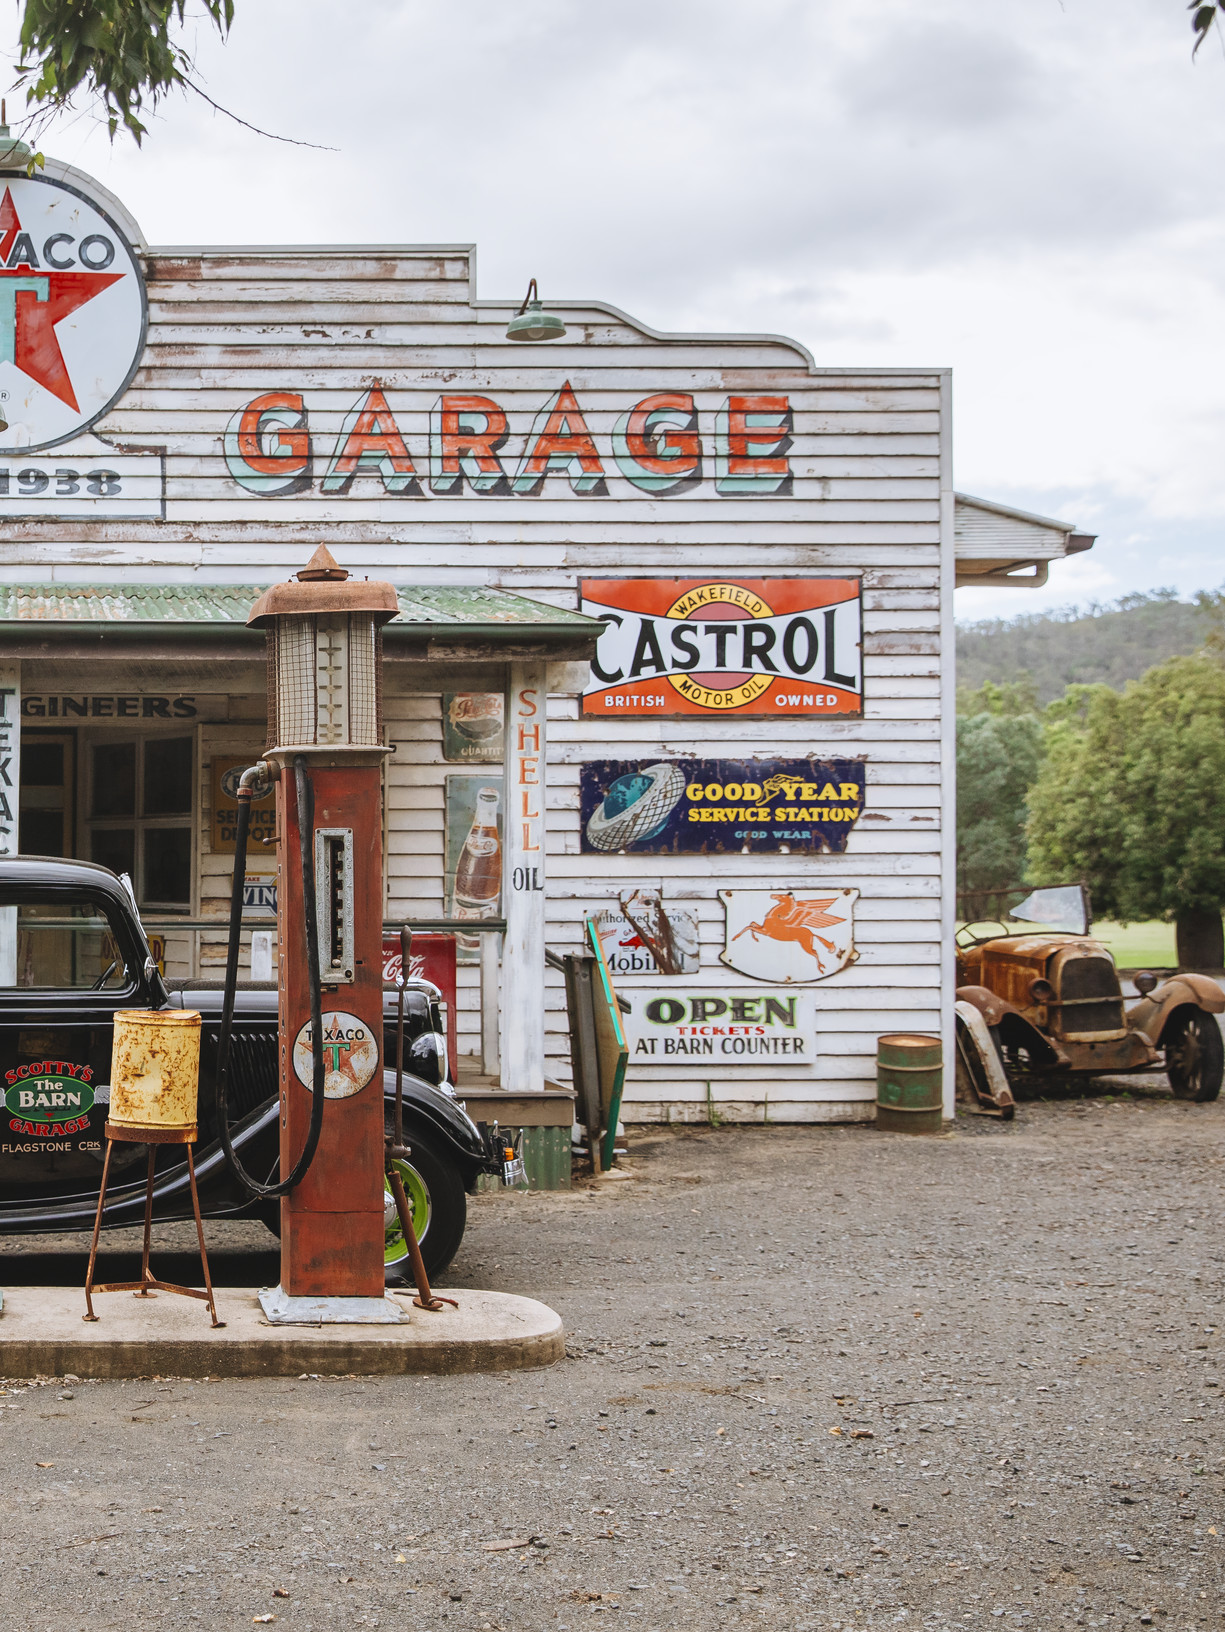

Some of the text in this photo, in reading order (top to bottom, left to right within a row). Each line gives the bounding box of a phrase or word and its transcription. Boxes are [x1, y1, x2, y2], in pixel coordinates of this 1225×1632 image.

[223, 379, 794, 497] GARAGE
[675, 587, 763, 615] WAKEFIELD
[591, 608, 856, 688] CASTROL
[605, 694, 838, 707] BRITISH OWNED
[680, 680, 765, 705] MOTOR OIL
[461, 745, 504, 755] QUANTIT
[517, 689, 540, 851] SHELL
[217, 809, 276, 824] SEVICE
[688, 807, 859, 822] SERVICE STATION
[735, 830, 812, 839] GOOD WEAR
[513, 867, 544, 891] OIL
[646, 997, 798, 1027] OPEN
[306, 1029, 365, 1041] TXACO
[677, 1026, 765, 1035] TICKETS
[635, 1037, 804, 1054] AT BARN COUNTER
[5, 1061, 94, 1084] SCOTTY'S
[34, 1079, 63, 1091] The
[19, 1091, 81, 1107] BARN
[9, 1115, 90, 1136] GARAGE
[2, 1141, 101, 1153] FLAGSTONE CRK
